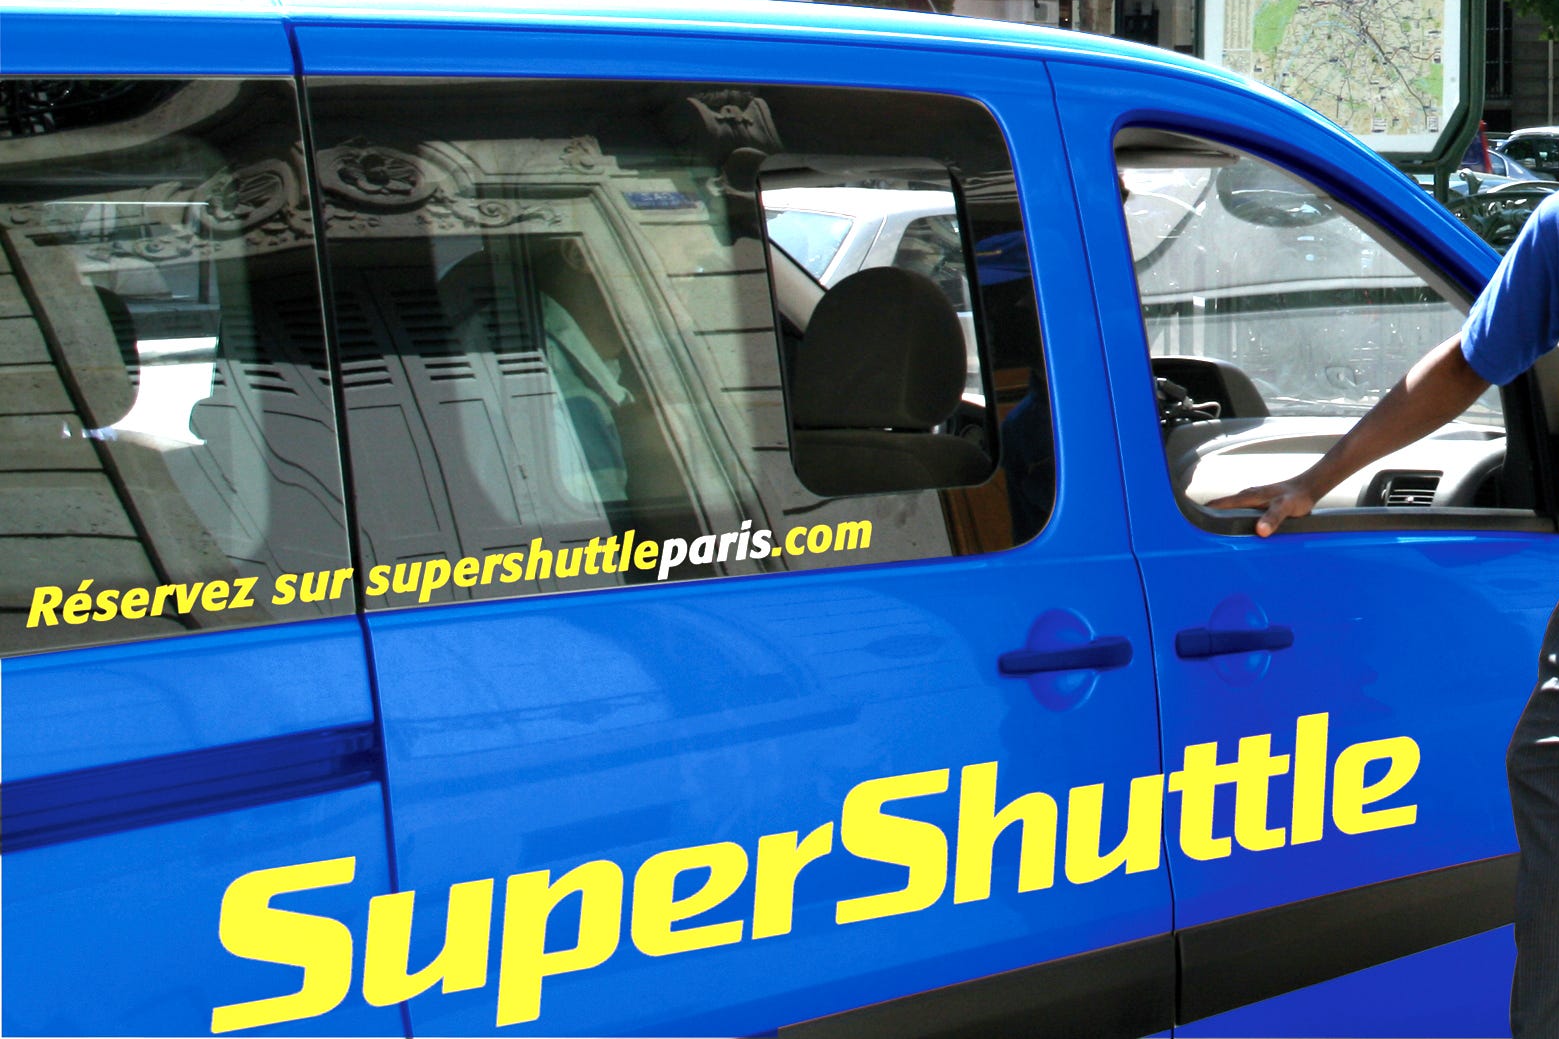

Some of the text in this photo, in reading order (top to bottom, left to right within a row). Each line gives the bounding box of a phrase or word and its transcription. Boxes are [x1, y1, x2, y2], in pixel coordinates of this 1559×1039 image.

[26, 519, 874, 628] Réservez sur supershuttleparis.com
[211, 712, 1422, 1033] SuperShuttle
